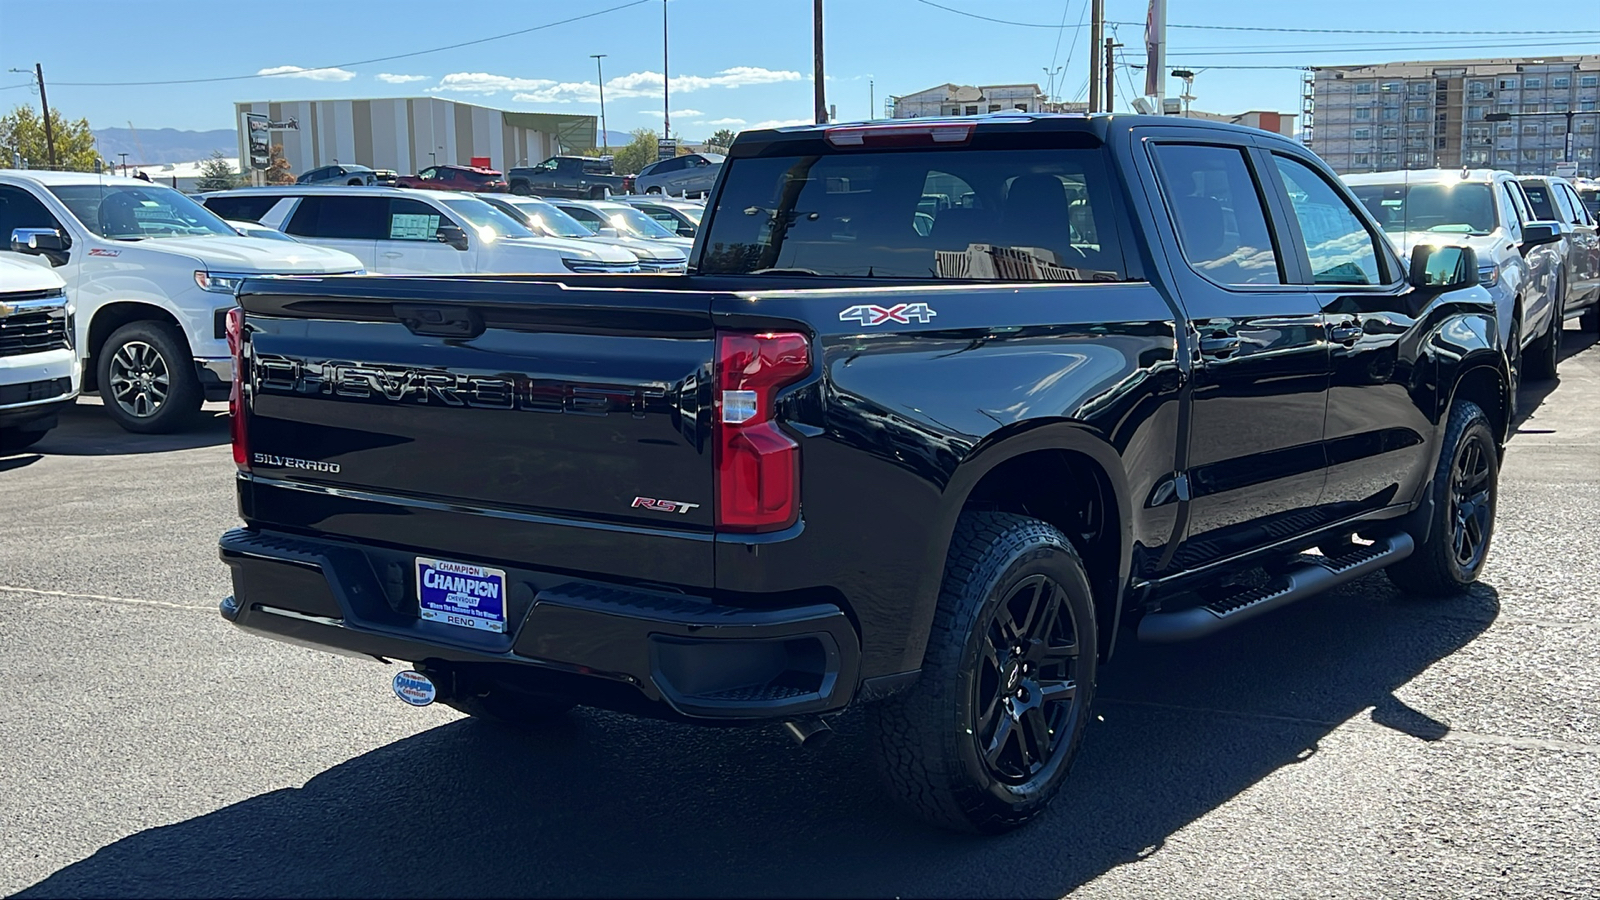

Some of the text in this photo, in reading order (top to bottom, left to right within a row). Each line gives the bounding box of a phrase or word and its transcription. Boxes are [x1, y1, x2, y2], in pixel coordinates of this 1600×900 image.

[259, 357, 666, 419] CHEVROLET
[254, 452, 340, 473] SILVERADO
[631, 496, 700, 514] RST
[439, 562, 480, 576] CHAMPION
[423, 568, 499, 599] CHAMPION
[447, 616, 475, 627] RENO
